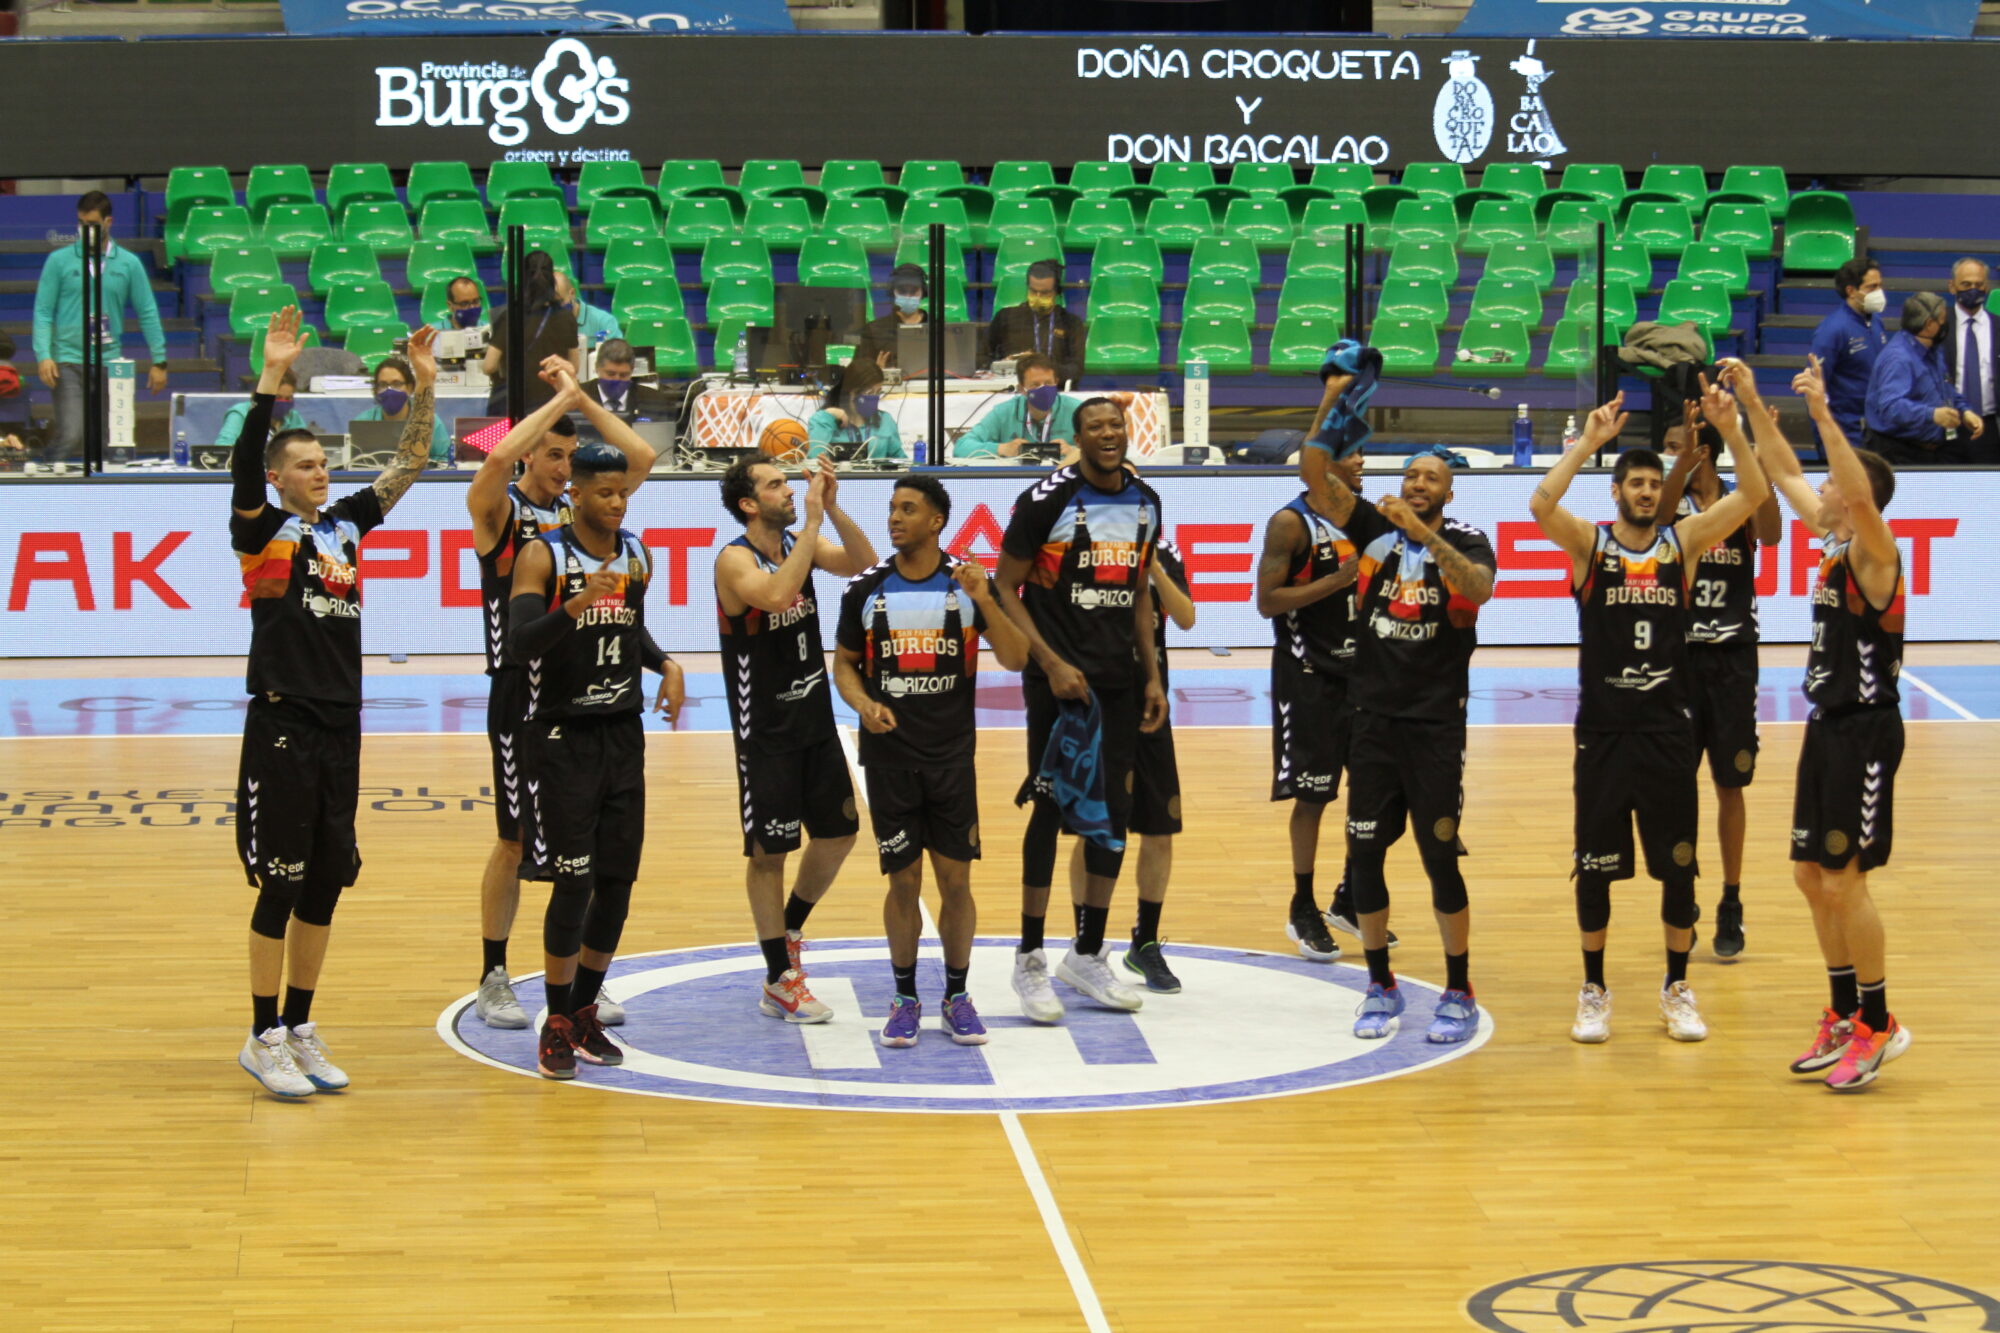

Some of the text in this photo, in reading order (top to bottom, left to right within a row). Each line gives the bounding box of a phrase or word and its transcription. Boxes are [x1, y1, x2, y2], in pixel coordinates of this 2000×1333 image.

[1660, 22, 1809, 35] GARCÍA
[1664, 10, 1807, 24] GRUPO
[421, 60, 509, 79] Provincia
[1077, 43, 1422, 82] DOÑA CROQUETA
[1234, 95, 1263, 125] Y
[1107, 134, 1390, 165] DON BACALAO
[1077, 549, 1140, 569] BURGO
[1378, 579, 1440, 606] BUGOS
[1605, 586, 1678, 607] BURGOS
[1695, 579, 1728, 608] 32
[575, 606, 637, 630] BURGOS
[797, 631, 808, 662] 8
[880, 636, 959, 658] BURGOS
[1634, 620, 1652, 650] 9
[596, 635, 621, 666] 14
[881, 673, 958, 699] HORIZONT
